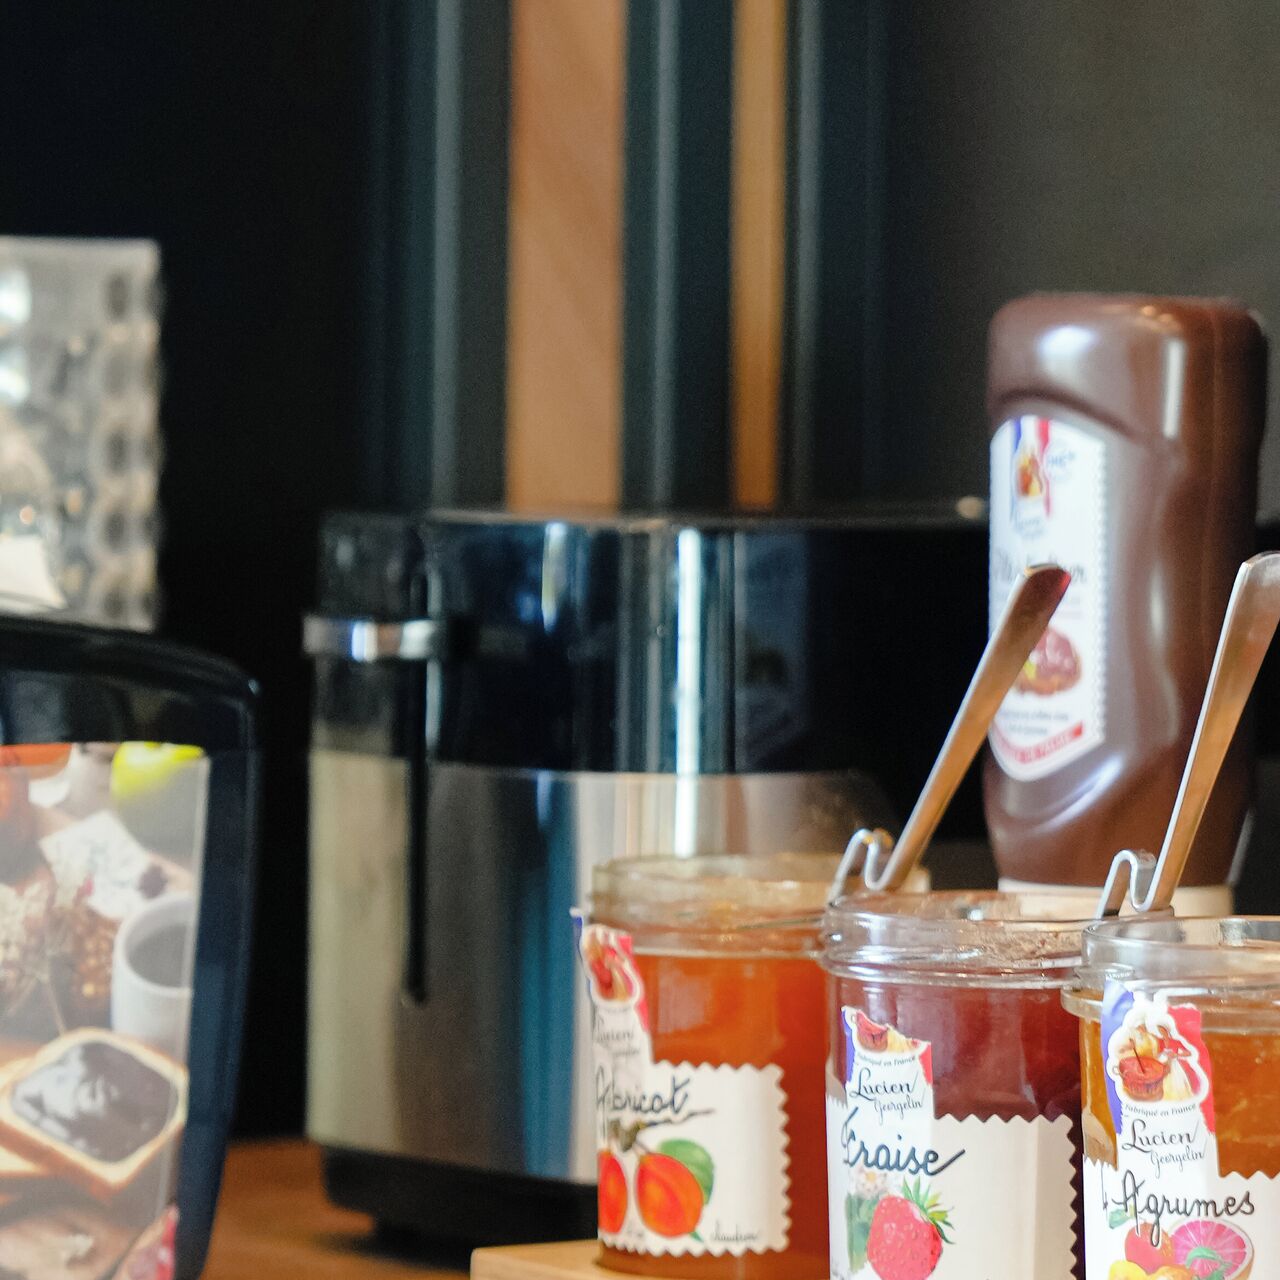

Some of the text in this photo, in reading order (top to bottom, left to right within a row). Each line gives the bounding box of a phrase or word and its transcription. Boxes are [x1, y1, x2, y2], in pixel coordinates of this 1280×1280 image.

[849, 1067, 918, 1101] Lucien
[874, 1090, 926, 1126] Georgelin
[841, 1107, 965, 1176] Fraise
[1121, 1119, 1199, 1153] Lucien
[1150, 1141, 1207, 1179] Georgelin
[1112, 1170, 1255, 1247] Agrumes
